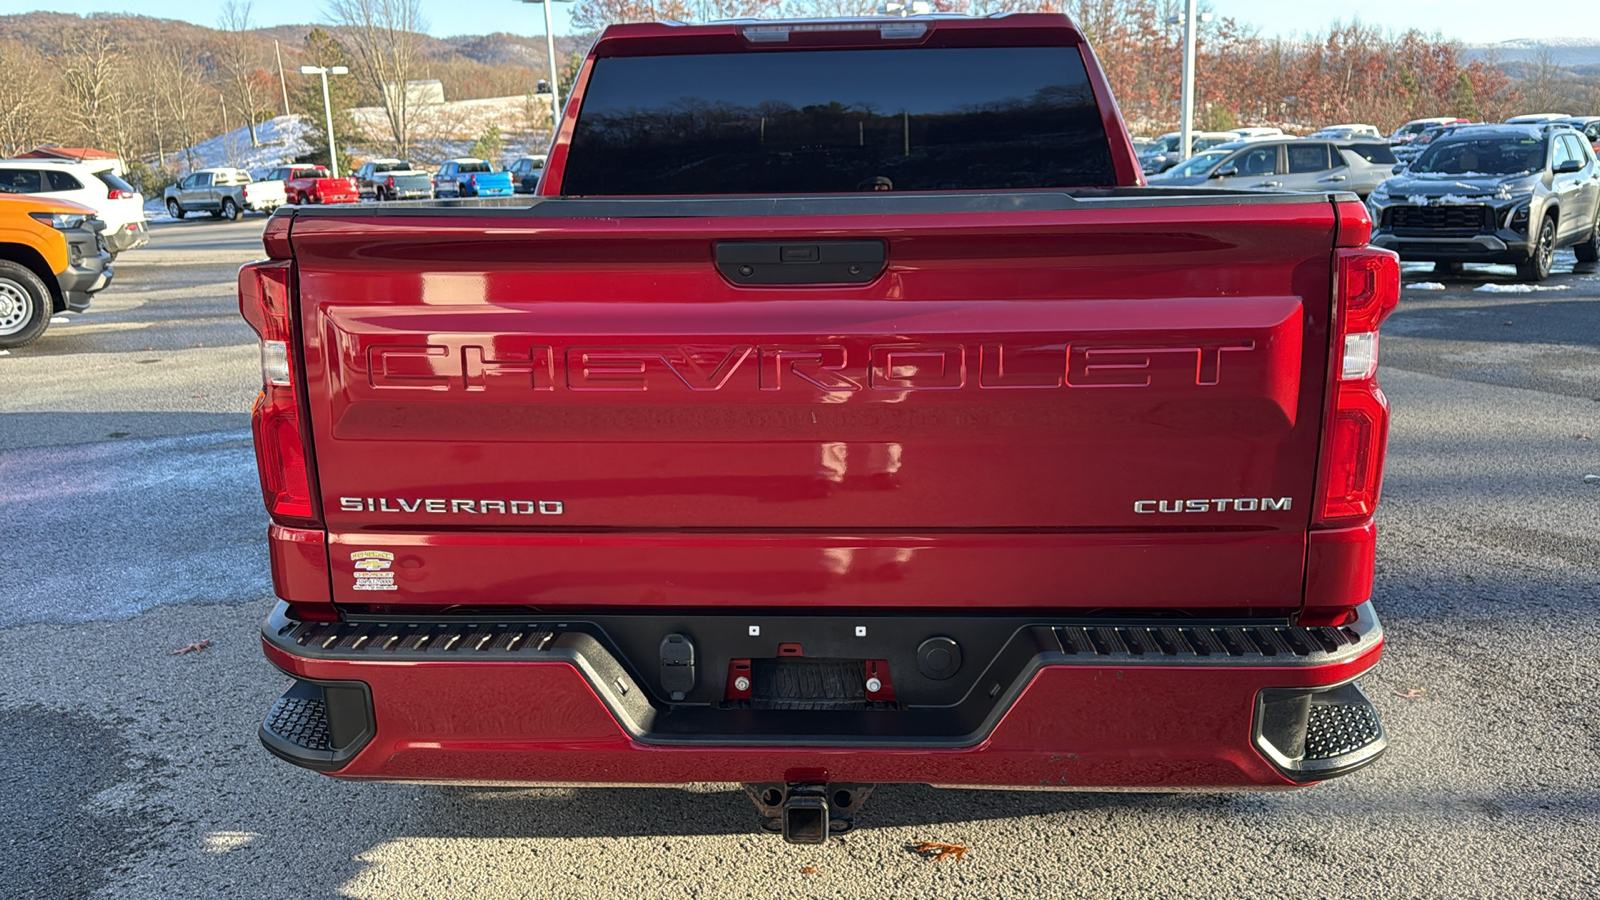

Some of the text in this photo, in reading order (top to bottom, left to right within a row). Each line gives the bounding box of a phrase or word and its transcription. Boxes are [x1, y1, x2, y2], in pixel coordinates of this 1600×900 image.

[366, 339, 1256, 393] CHEVROLET
[339, 496, 564, 515] SILVERADO
[1133, 496, 1293, 514] CUSTOM
